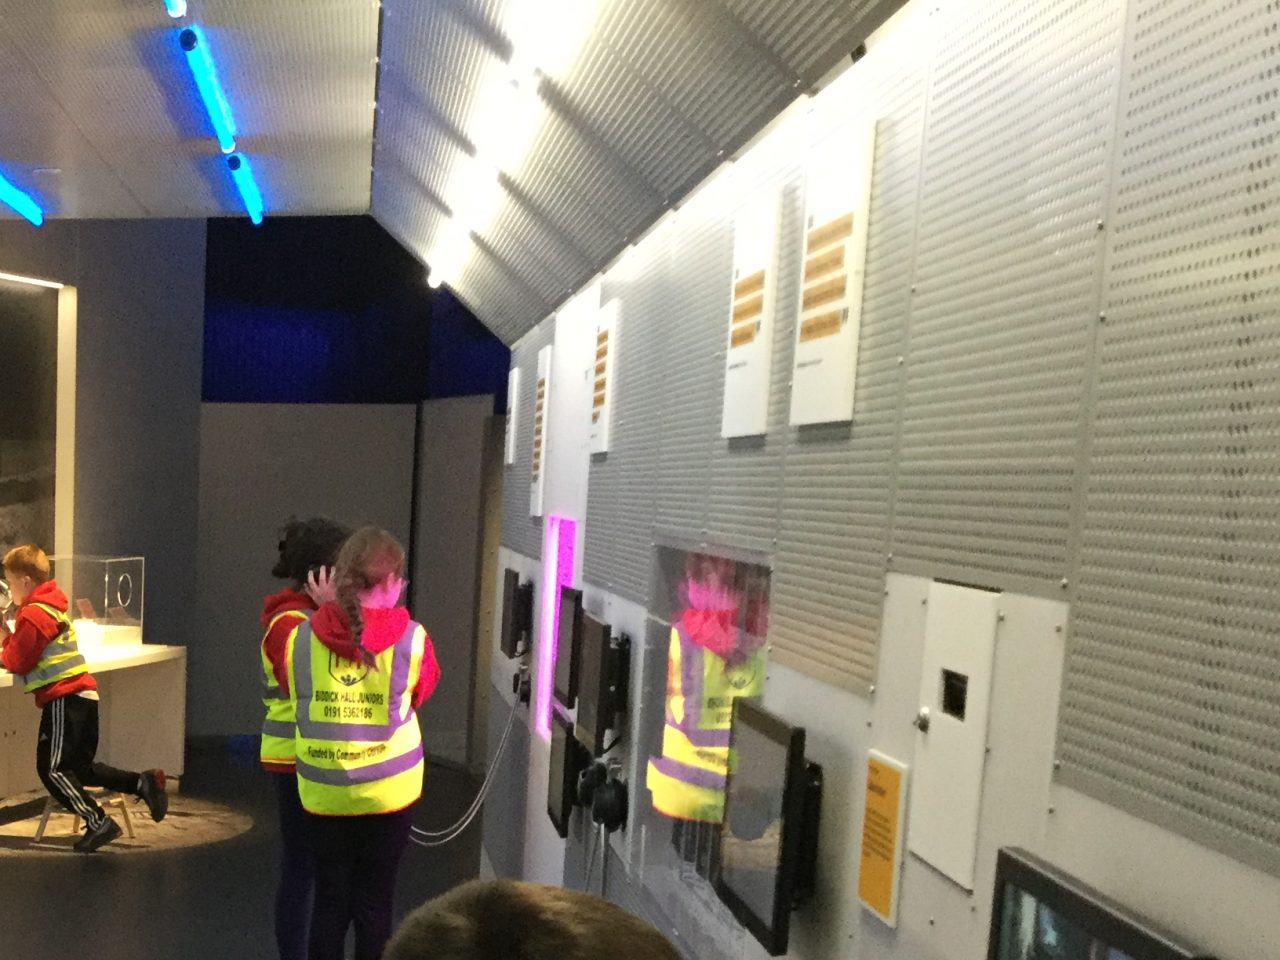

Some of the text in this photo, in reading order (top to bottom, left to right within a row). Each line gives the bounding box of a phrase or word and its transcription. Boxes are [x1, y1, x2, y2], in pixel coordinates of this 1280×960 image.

[340, 691, 356, 703] HALL
[357, 691, 384, 705] JUNIORS
[324, 706, 341, 719] 0191
[328, 749, 335, 762] by
